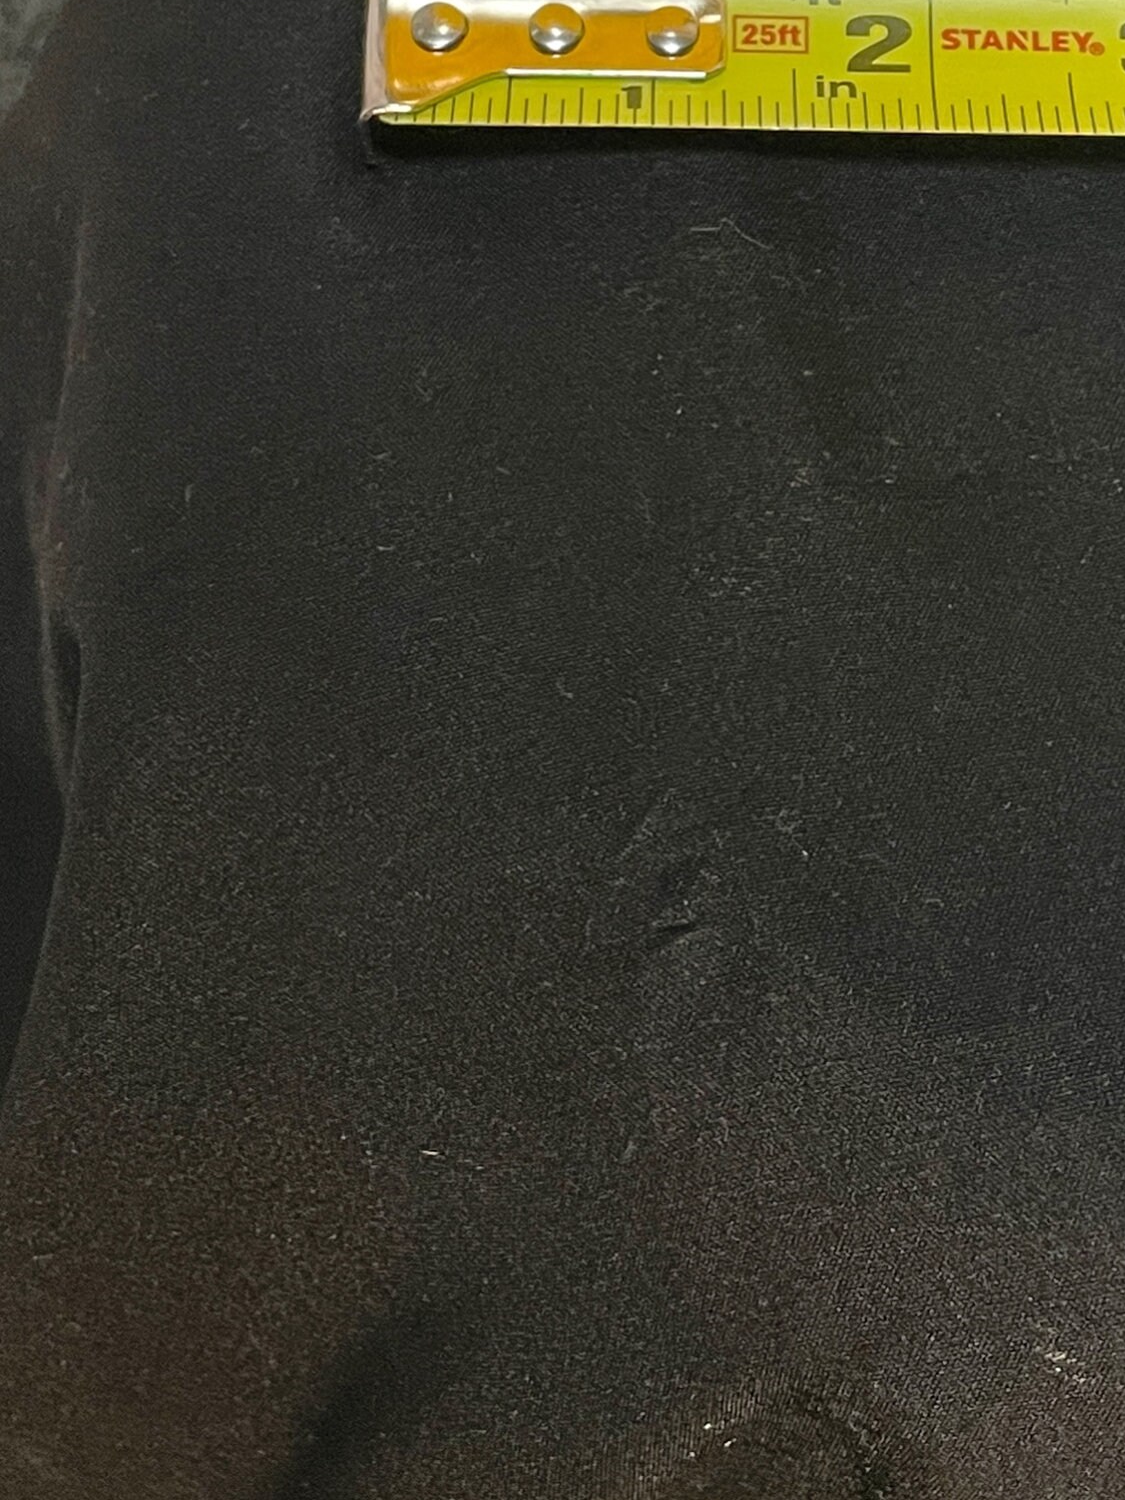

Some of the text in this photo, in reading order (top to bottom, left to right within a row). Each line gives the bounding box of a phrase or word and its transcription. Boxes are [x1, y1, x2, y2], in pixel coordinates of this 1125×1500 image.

[741, 23, 802, 46] 25ft
[845, 15, 912, 73] 2
[621, 86, 642, 109] 1
[816, 75, 857, 98] in
